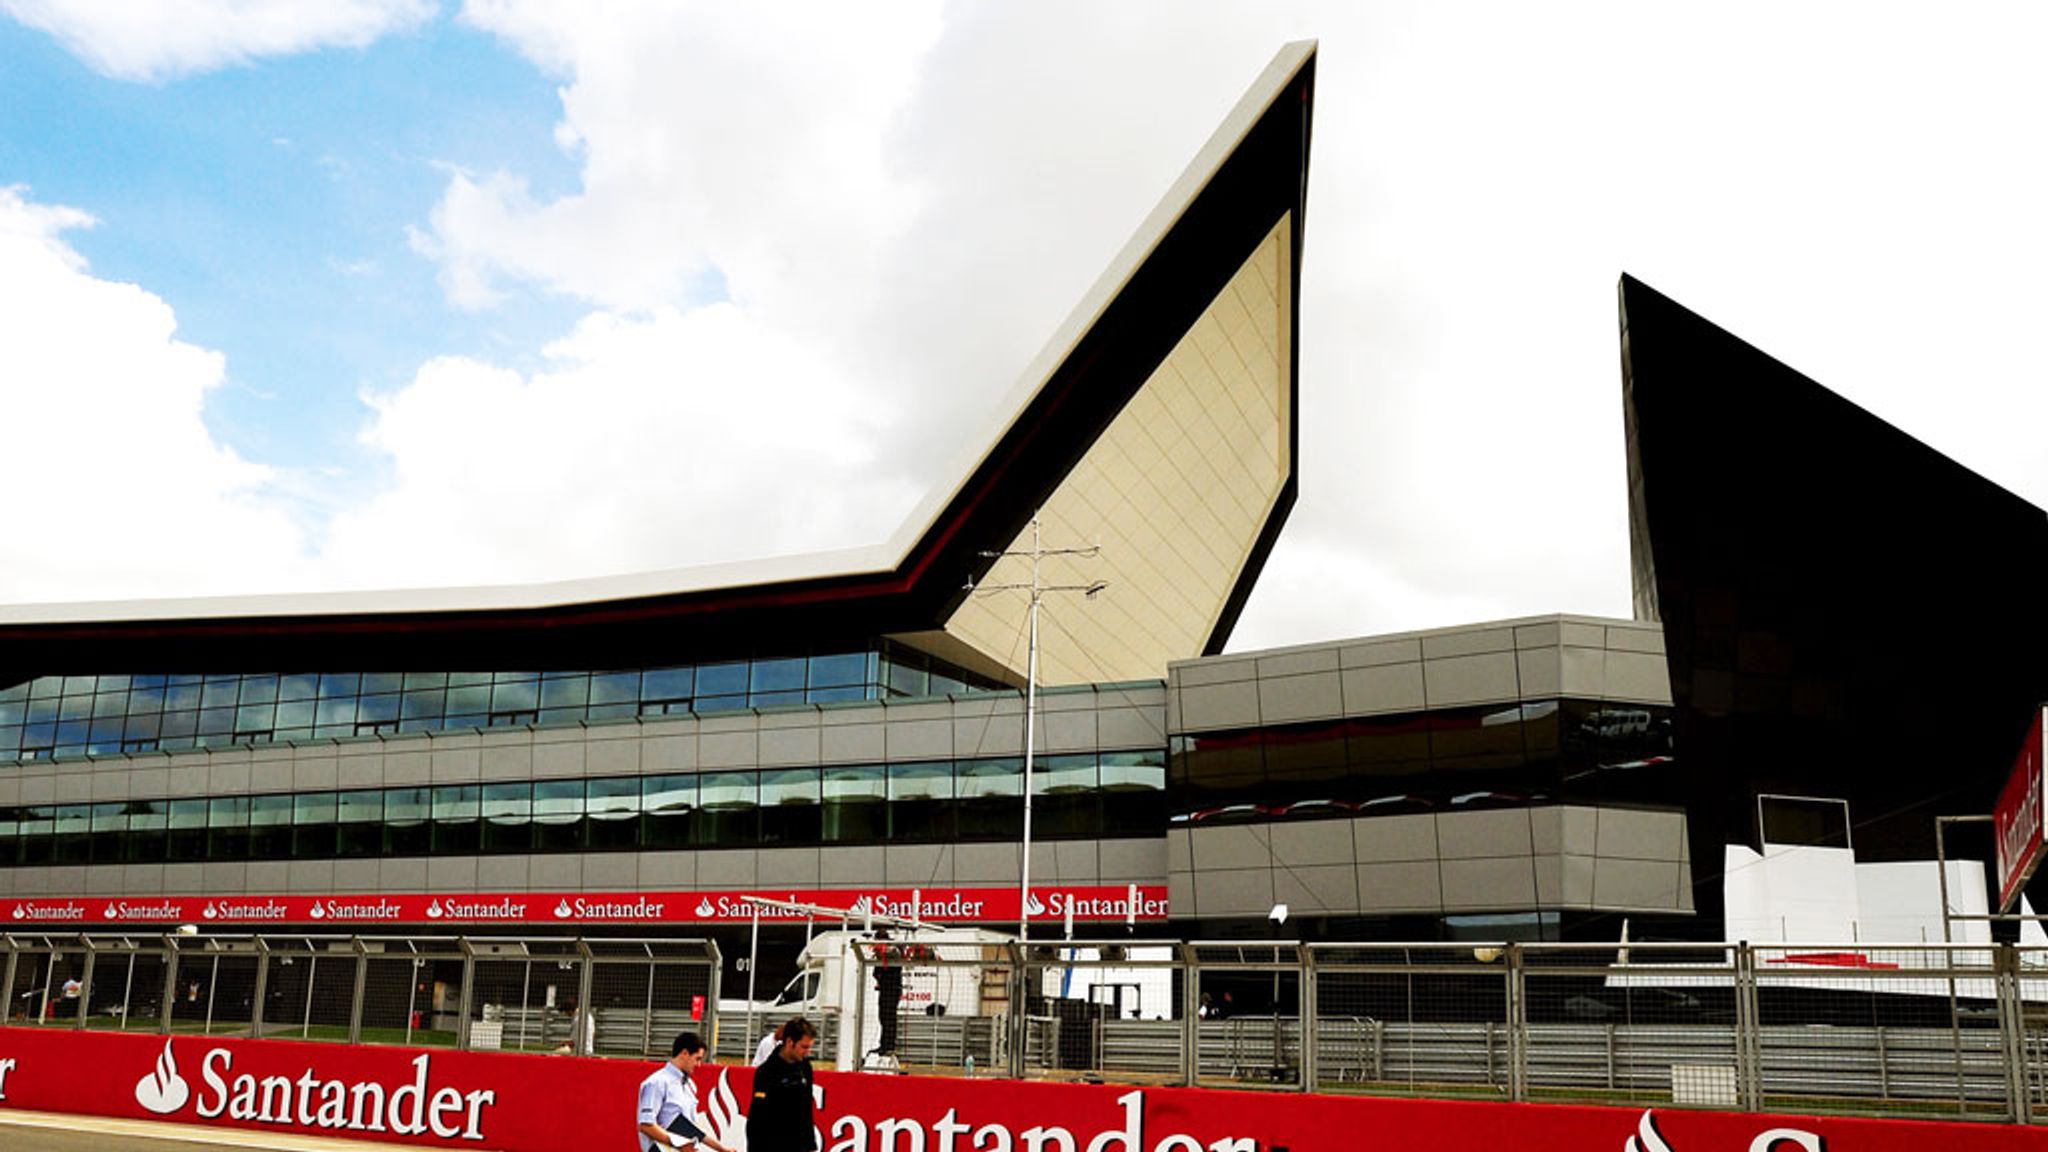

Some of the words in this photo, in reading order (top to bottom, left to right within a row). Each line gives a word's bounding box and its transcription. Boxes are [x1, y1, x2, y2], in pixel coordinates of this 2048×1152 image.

[26, 902, 84, 918] Santander
[118, 900, 181, 918] Santander
[218, 899, 287, 918] Santander
[325, 898, 401, 918] Santander
[444, 897, 526, 918] Santander
[574, 896, 664, 918] Santander
[717, 894, 817, 917] Sanand
[875, 893, 984, 917] Sanander
[196, 1047, 495, 1141] Santander
